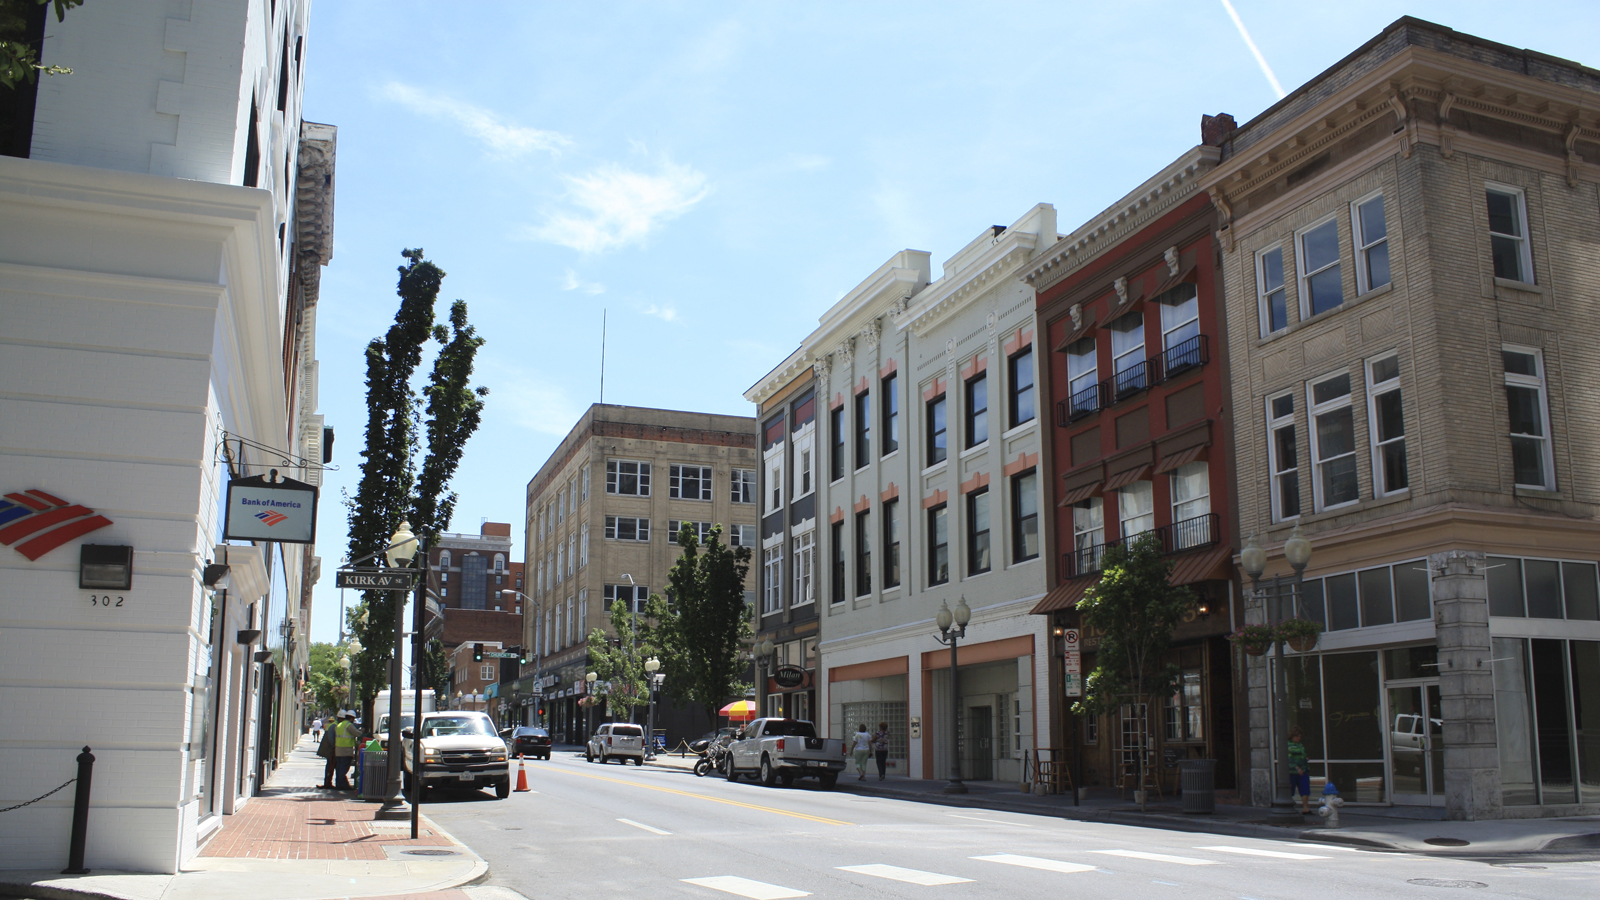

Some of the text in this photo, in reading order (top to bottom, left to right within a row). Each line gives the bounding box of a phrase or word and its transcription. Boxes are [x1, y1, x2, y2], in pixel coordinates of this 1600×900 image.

[242, 498, 261, 506] Bank
[270, 500, 301, 508] America
[345, 575, 376, 585] KIRK
[377, 576, 393, 586] AV
[91, 595, 124, 607] 302
